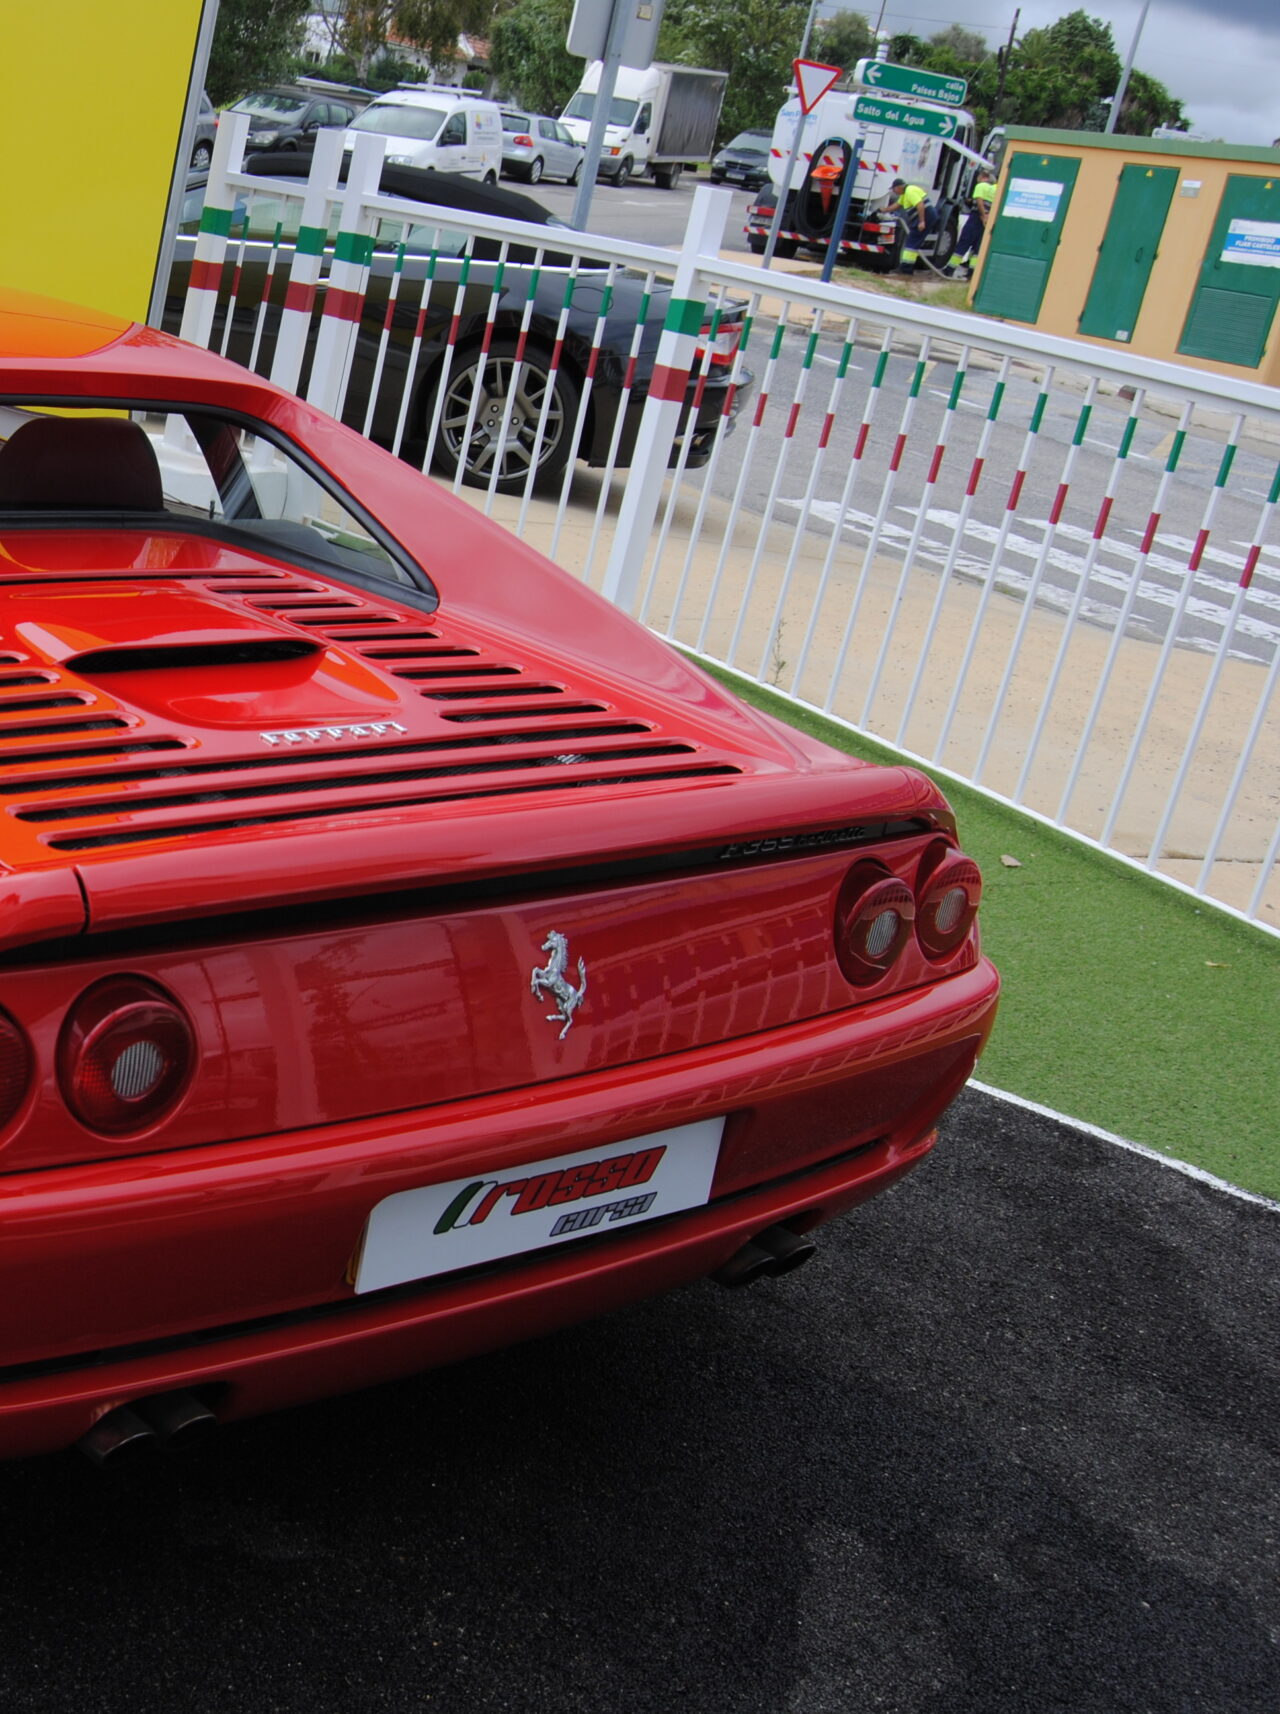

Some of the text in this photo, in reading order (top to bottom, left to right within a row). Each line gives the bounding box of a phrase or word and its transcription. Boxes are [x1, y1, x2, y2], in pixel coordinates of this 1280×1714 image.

[937, 88, 960, 102] Bajos
[945, 81, 964, 92] calle
[856, 103, 926, 126] Salto del Agua
[260, 721, 408, 745] Ferrari
[469, 1144, 668, 1226] rosso
[549, 1191, 658, 1238] corsa
